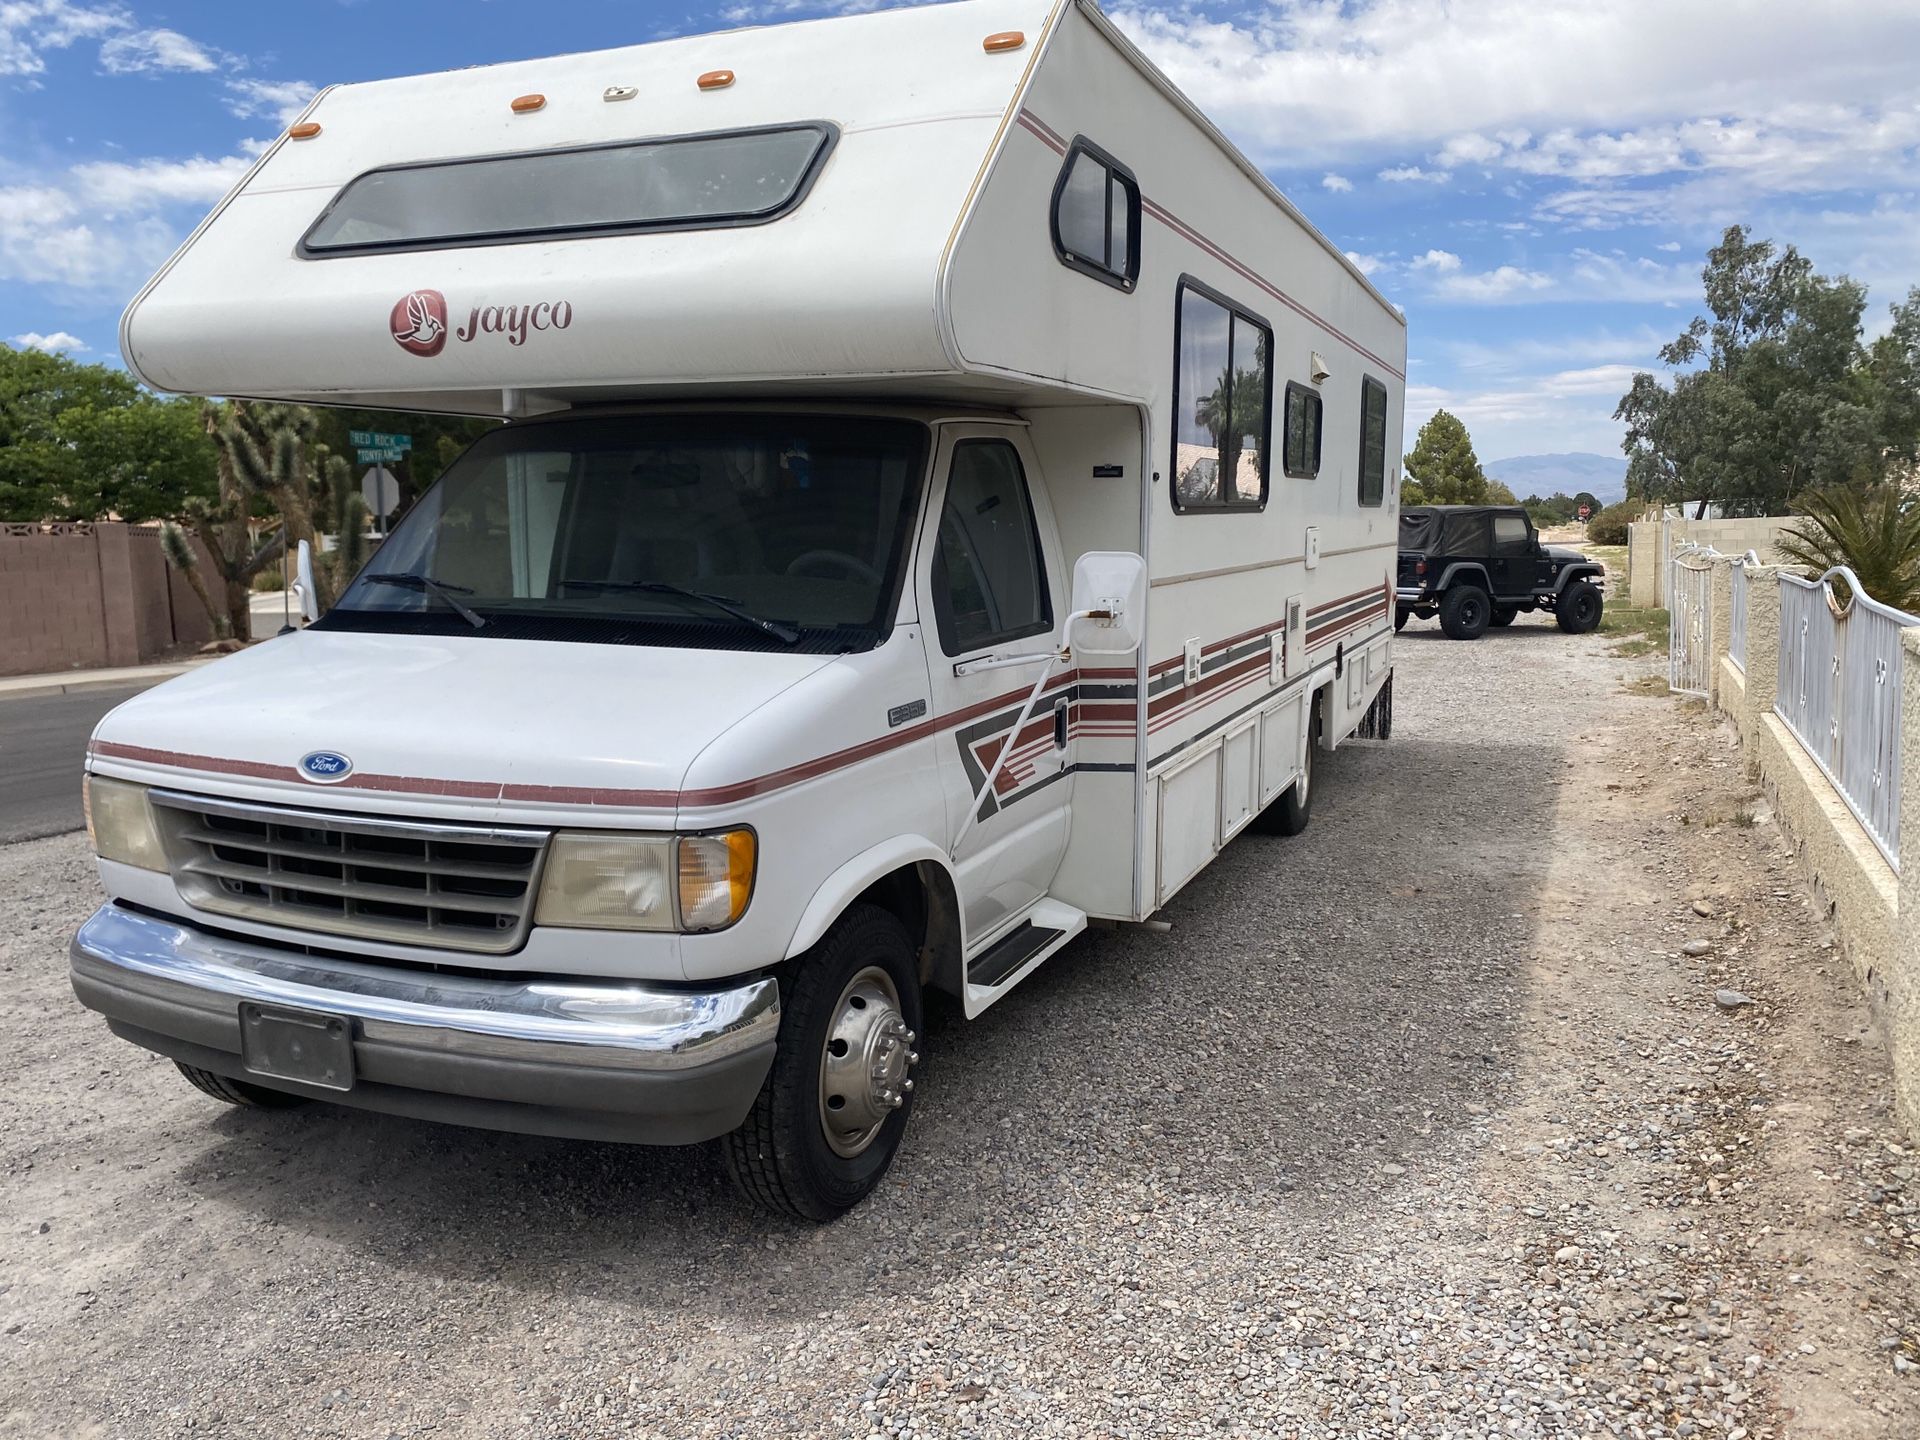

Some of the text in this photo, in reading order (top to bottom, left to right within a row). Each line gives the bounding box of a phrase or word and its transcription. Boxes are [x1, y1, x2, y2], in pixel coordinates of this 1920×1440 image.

[354, 432, 371, 445] RED
[374, 434, 396, 448] ROCK
[311, 756, 339, 772] Ford
